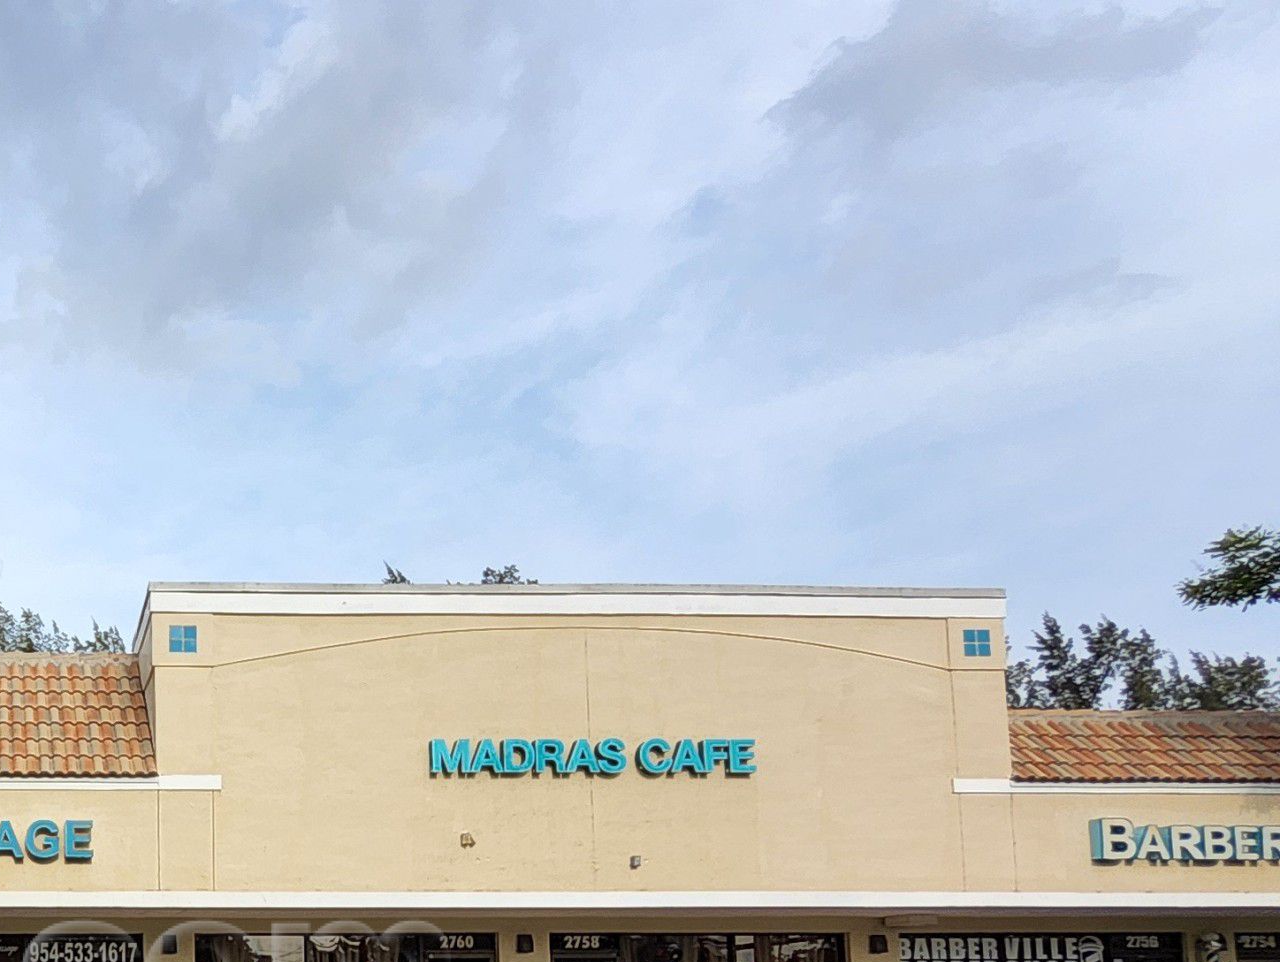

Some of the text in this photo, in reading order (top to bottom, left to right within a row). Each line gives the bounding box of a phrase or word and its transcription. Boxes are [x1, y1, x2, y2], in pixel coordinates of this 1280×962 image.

[429, 738, 757, 777] MADRAS CAFE
[440, 935, 474, 948] 2760
[564, 935, 600, 948] 2758
[899, 937, 1080, 960] BARBER VILLE
[1126, 935, 1160, 948] 2756
[30, 942, 138, 962] 954-533-1617
